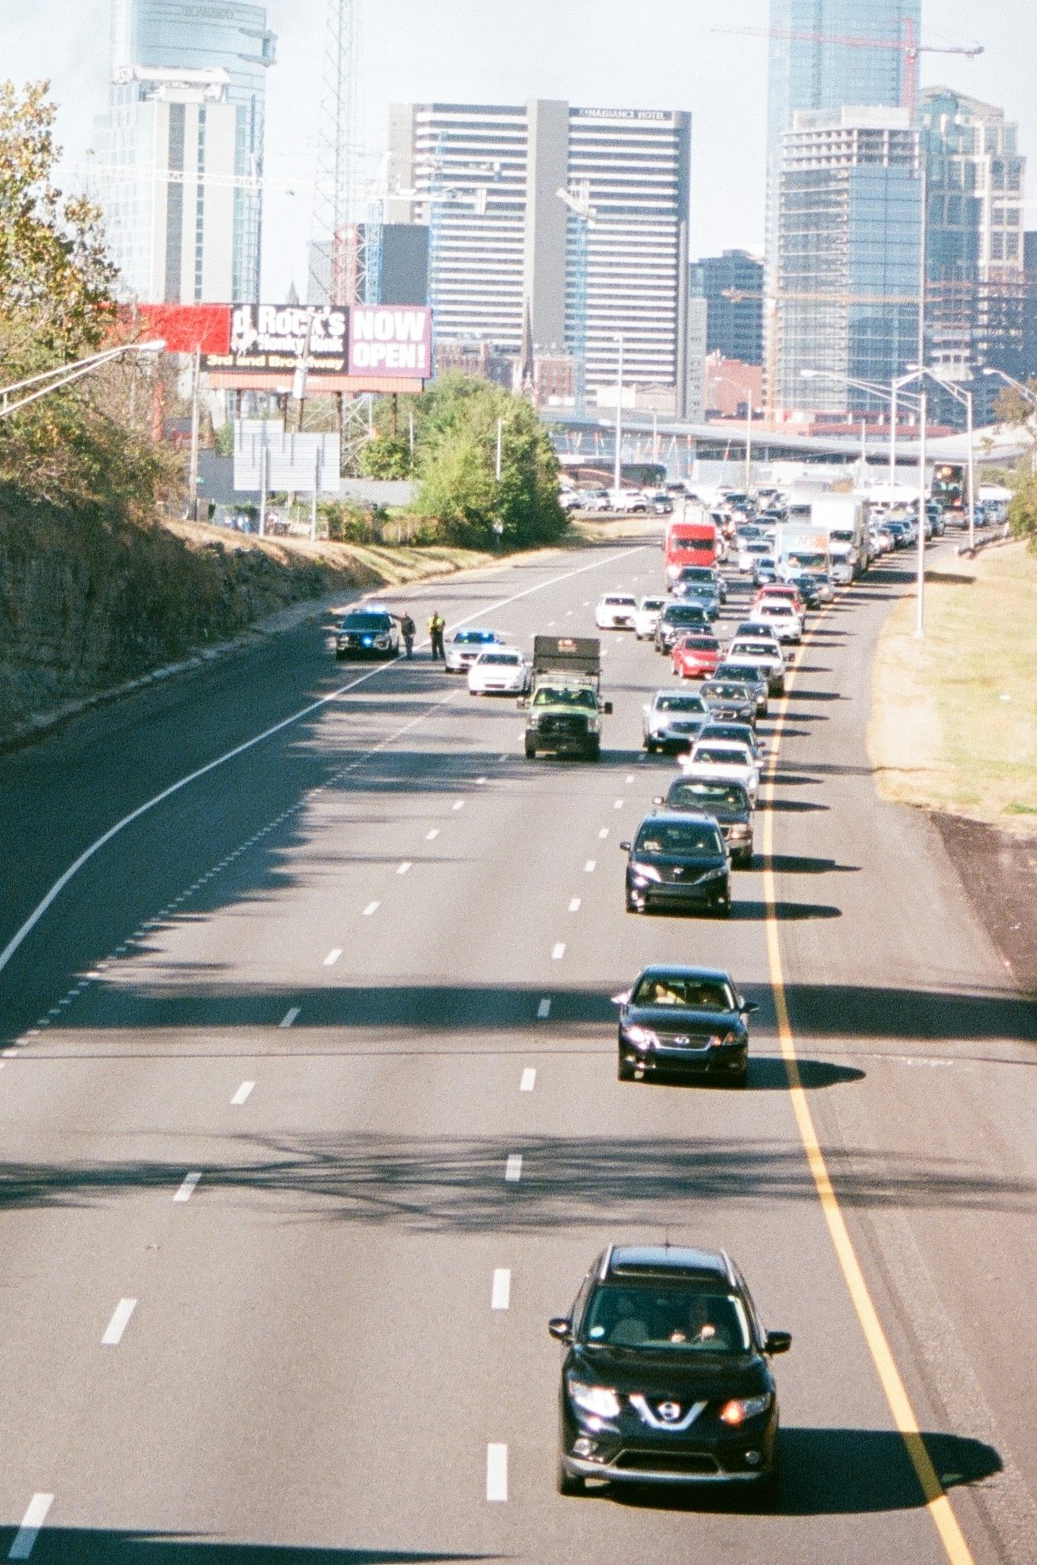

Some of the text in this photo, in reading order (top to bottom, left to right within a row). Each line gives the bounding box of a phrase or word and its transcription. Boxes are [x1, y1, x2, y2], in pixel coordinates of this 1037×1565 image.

[638, 110, 665, 120] HOTEL
[258, 305, 346, 336] Rock's
[353, 310, 426, 341] NOW
[256, 334, 344, 355] Honky Tonk
[353, 342, 426, 369] OPEN!
[206, 354, 345, 370] 3rd and Brodway
